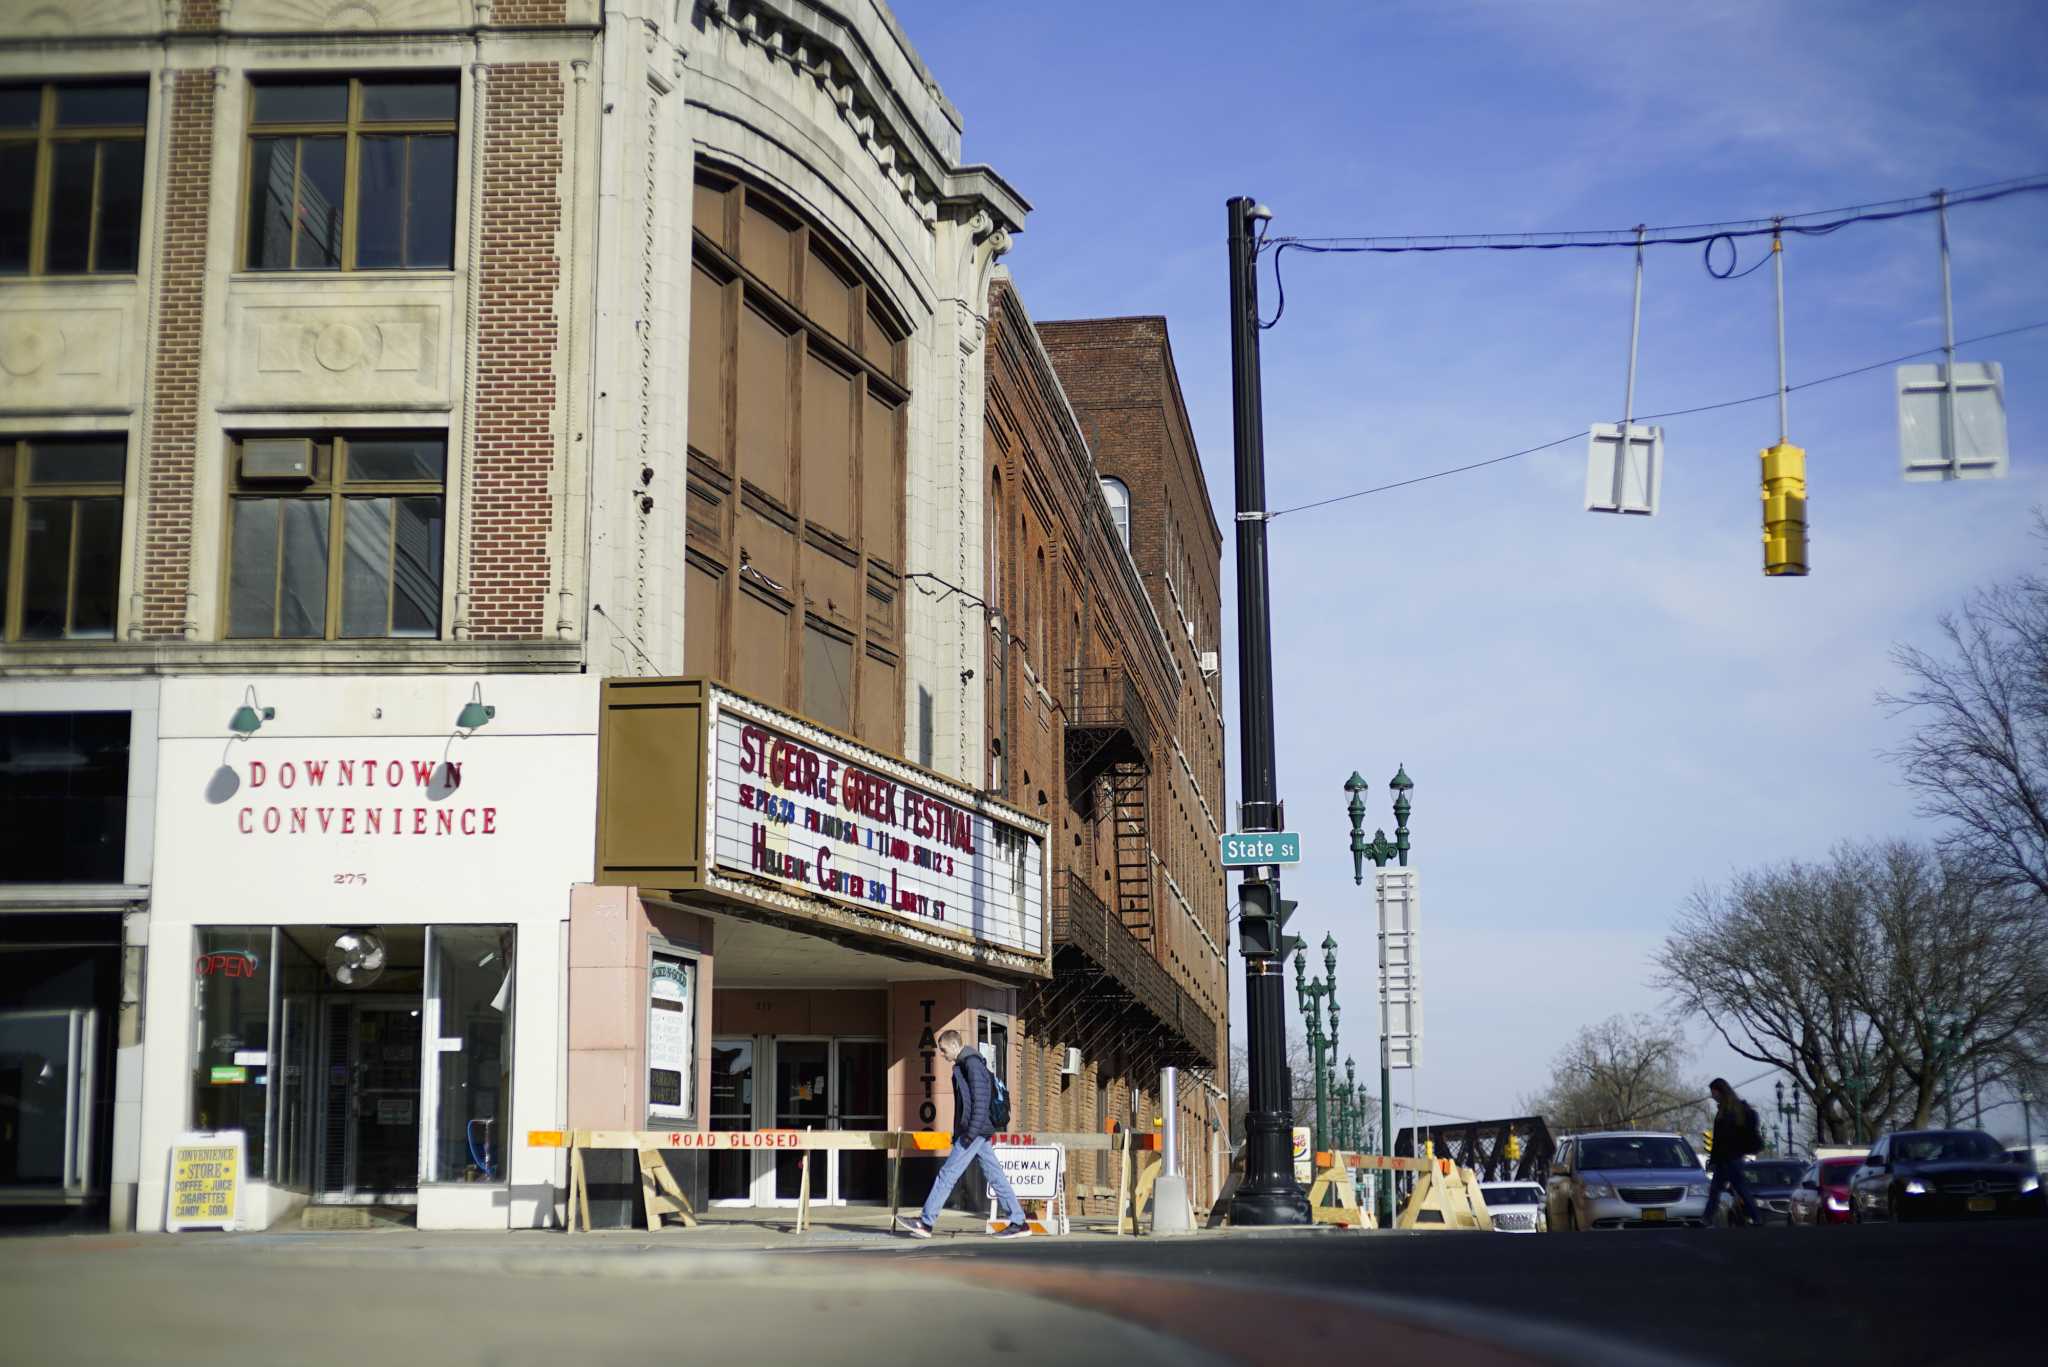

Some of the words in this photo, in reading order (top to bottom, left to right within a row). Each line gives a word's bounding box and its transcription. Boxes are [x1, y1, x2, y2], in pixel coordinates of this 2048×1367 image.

[249, 760, 463, 789] DOWNTOWN
[740, 725, 769, 778] ST.
[770, 737, 839, 806] GEORGE
[843, 767, 897, 828] GREEK
[903, 789, 976, 856] FESTIVAL
[238, 806, 497, 836] CONVENIENCE
[1228, 840, 1274, 858] State
[1281, 844, 1294, 857] St
[333, 873, 367, 885] 275
[752, 822, 811, 884] HELLENIC
[817, 845, 864, 899] CENTER
[932, 899, 946, 922] ST
[195, 954, 255, 977] OPEN
[918, 1000, 938, 1133] TATTO
[671, 1133, 716, 1147] ROAD
[730, 1133, 798, 1147] CLOSED
[177, 1148, 234, 1161] CONVENIENCE
[187, 1163, 222, 1179] STORE
[999, 1160, 1051, 1170] SIDEWALK
[175, 1180, 203, 1192] COFFEE
[211, 1179, 232, 1191] JUICE
[1006, 1175, 1044, 1185] LOSED
[179, 1192, 225, 1204] CIGARETTES
[176, 1205, 199, 1217] CANDY
[208, 1205, 228, 1217] SODA
